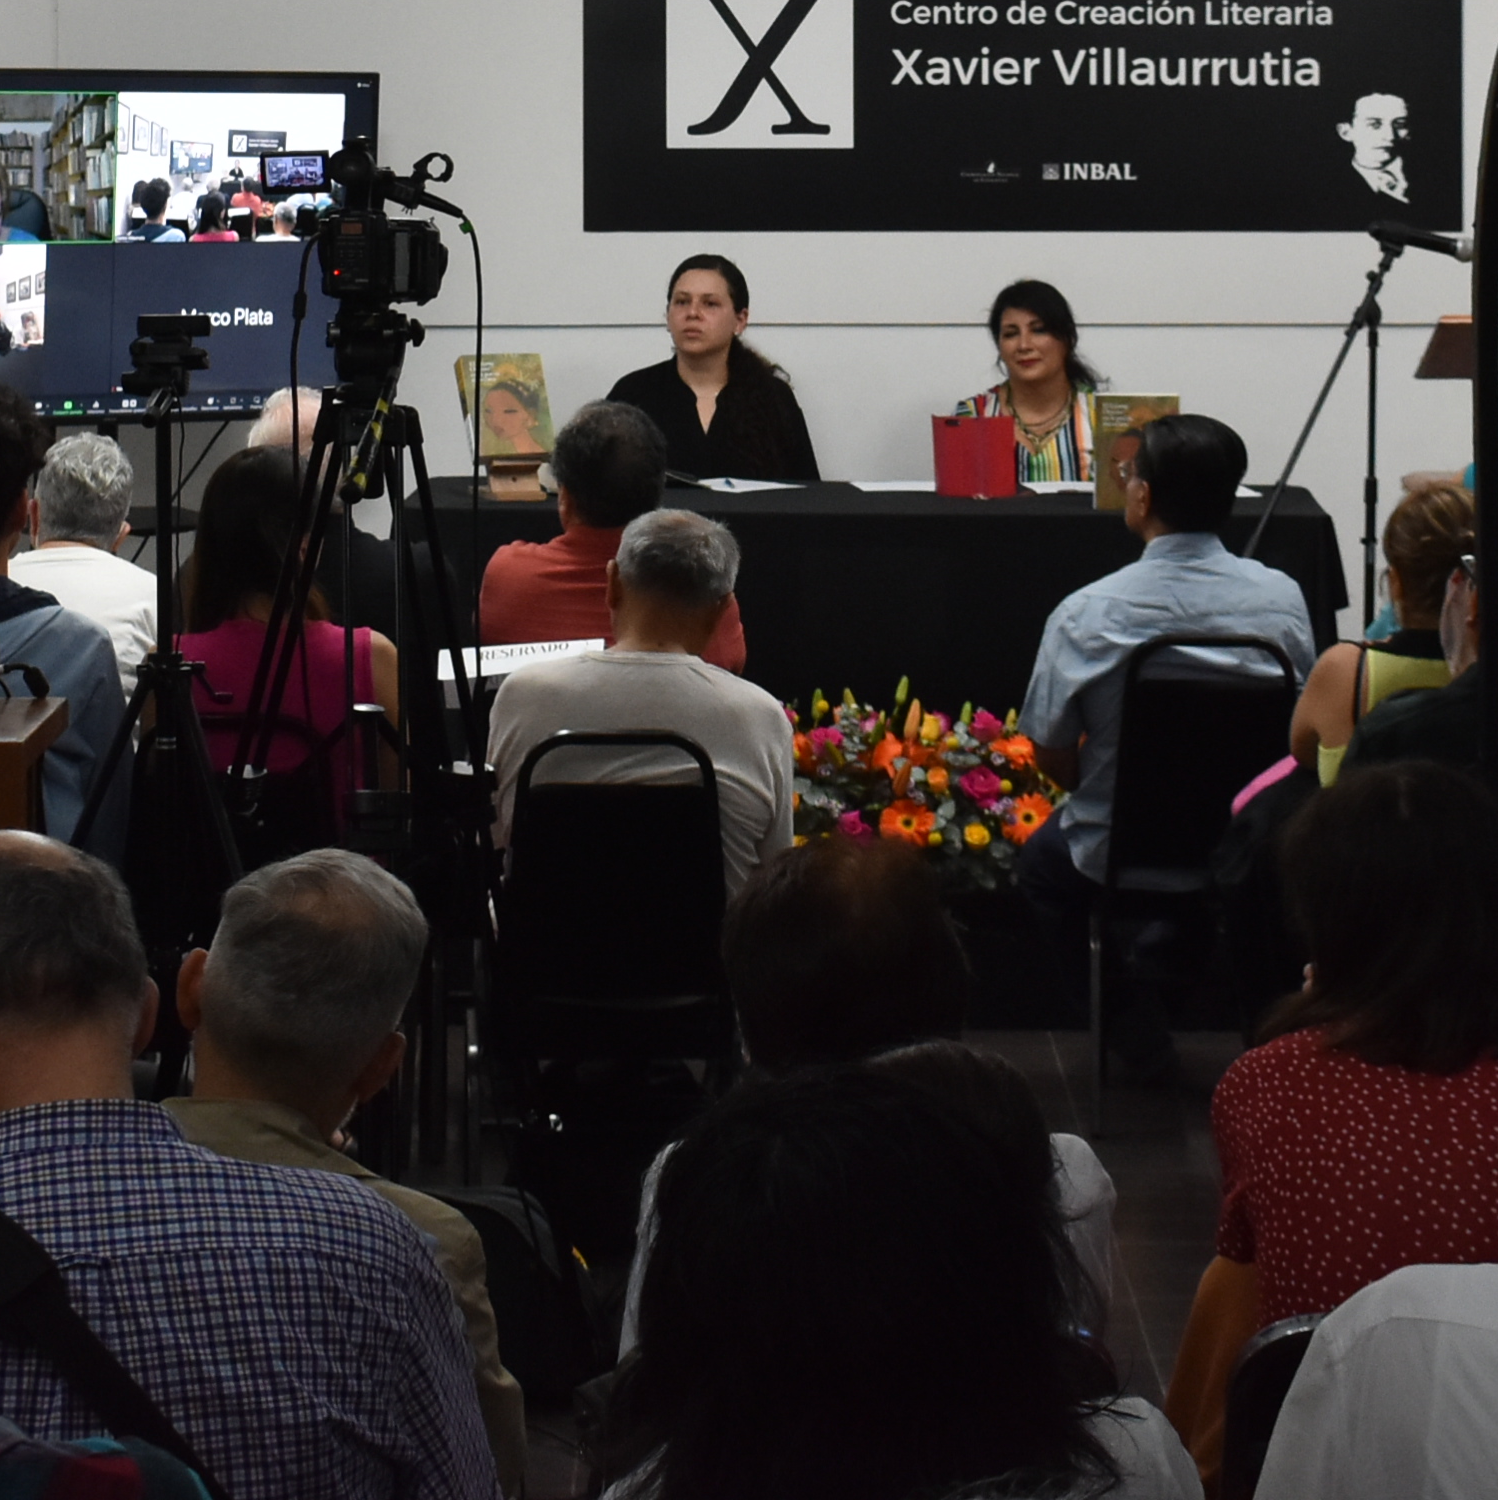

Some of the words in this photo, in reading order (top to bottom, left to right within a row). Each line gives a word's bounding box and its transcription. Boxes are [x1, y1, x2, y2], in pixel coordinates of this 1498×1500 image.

[890, 0, 998, 26] Centro
[1006, 0, 1047, 26] de
[1055, 0, 1195, 26] Creación
[1205, 0, 1333, 26] Literaria
[891, 47, 1041, 87] Xavier
[1052, 47, 1320, 87] Villaurrutia
[1063, 162, 1138, 181] INBAL
[233, 307, 274, 326] Plata
[481, 642, 570, 661] RESERVADO
